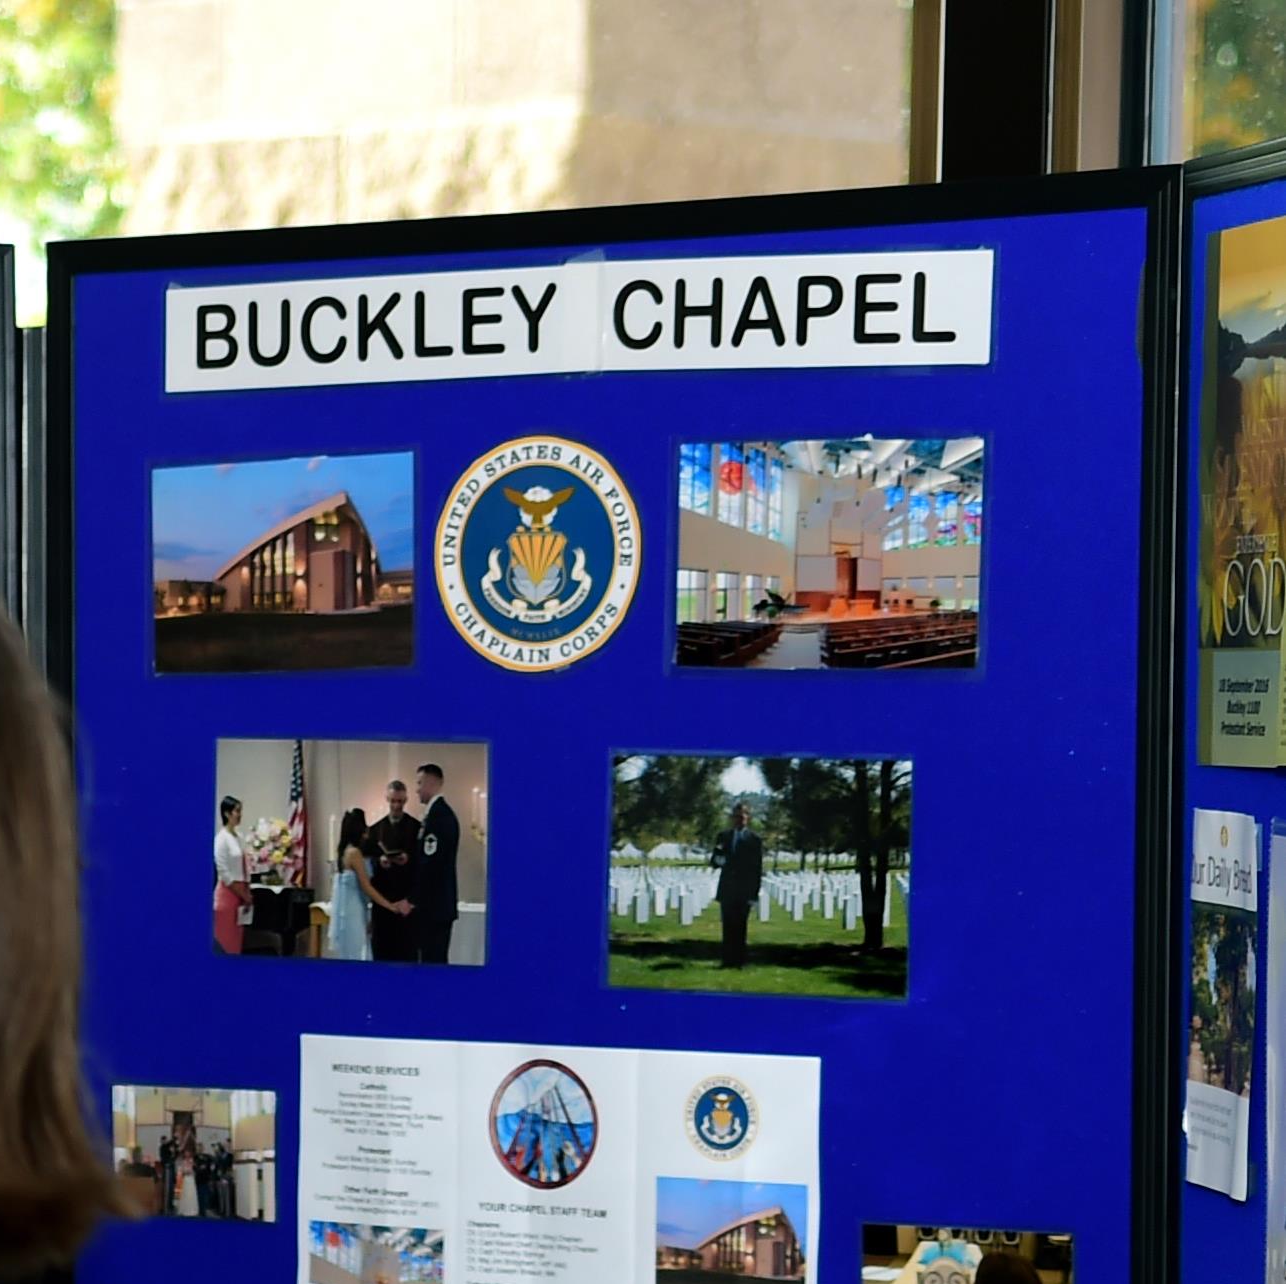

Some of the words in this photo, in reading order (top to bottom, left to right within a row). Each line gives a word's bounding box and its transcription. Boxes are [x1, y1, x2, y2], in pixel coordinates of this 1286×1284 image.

[195, 283, 558, 370] BUCKLEY
[612, 271, 957, 350] CHAPEL
[443, 479, 480, 566] UNITED
[484, 444, 563, 478] STATES
[569, 454, 605, 485] AIR
[605, 488, 633, 567] FORCE
[455, 601, 550, 664] CHAPLAIN
[559, 603, 618, 658] CORPS
[1208, 856, 1231, 896] Daily
[1234, 859, 1252, 893] Bread
[375, 1066, 420, 1076] SERVICES
[479, 1202, 506, 1212] YOUR
[510, 1204, 547, 1215] CHAPEL
[550, 1206, 577, 1215] STAFF
[581, 1208, 607, 1218] TEAM
